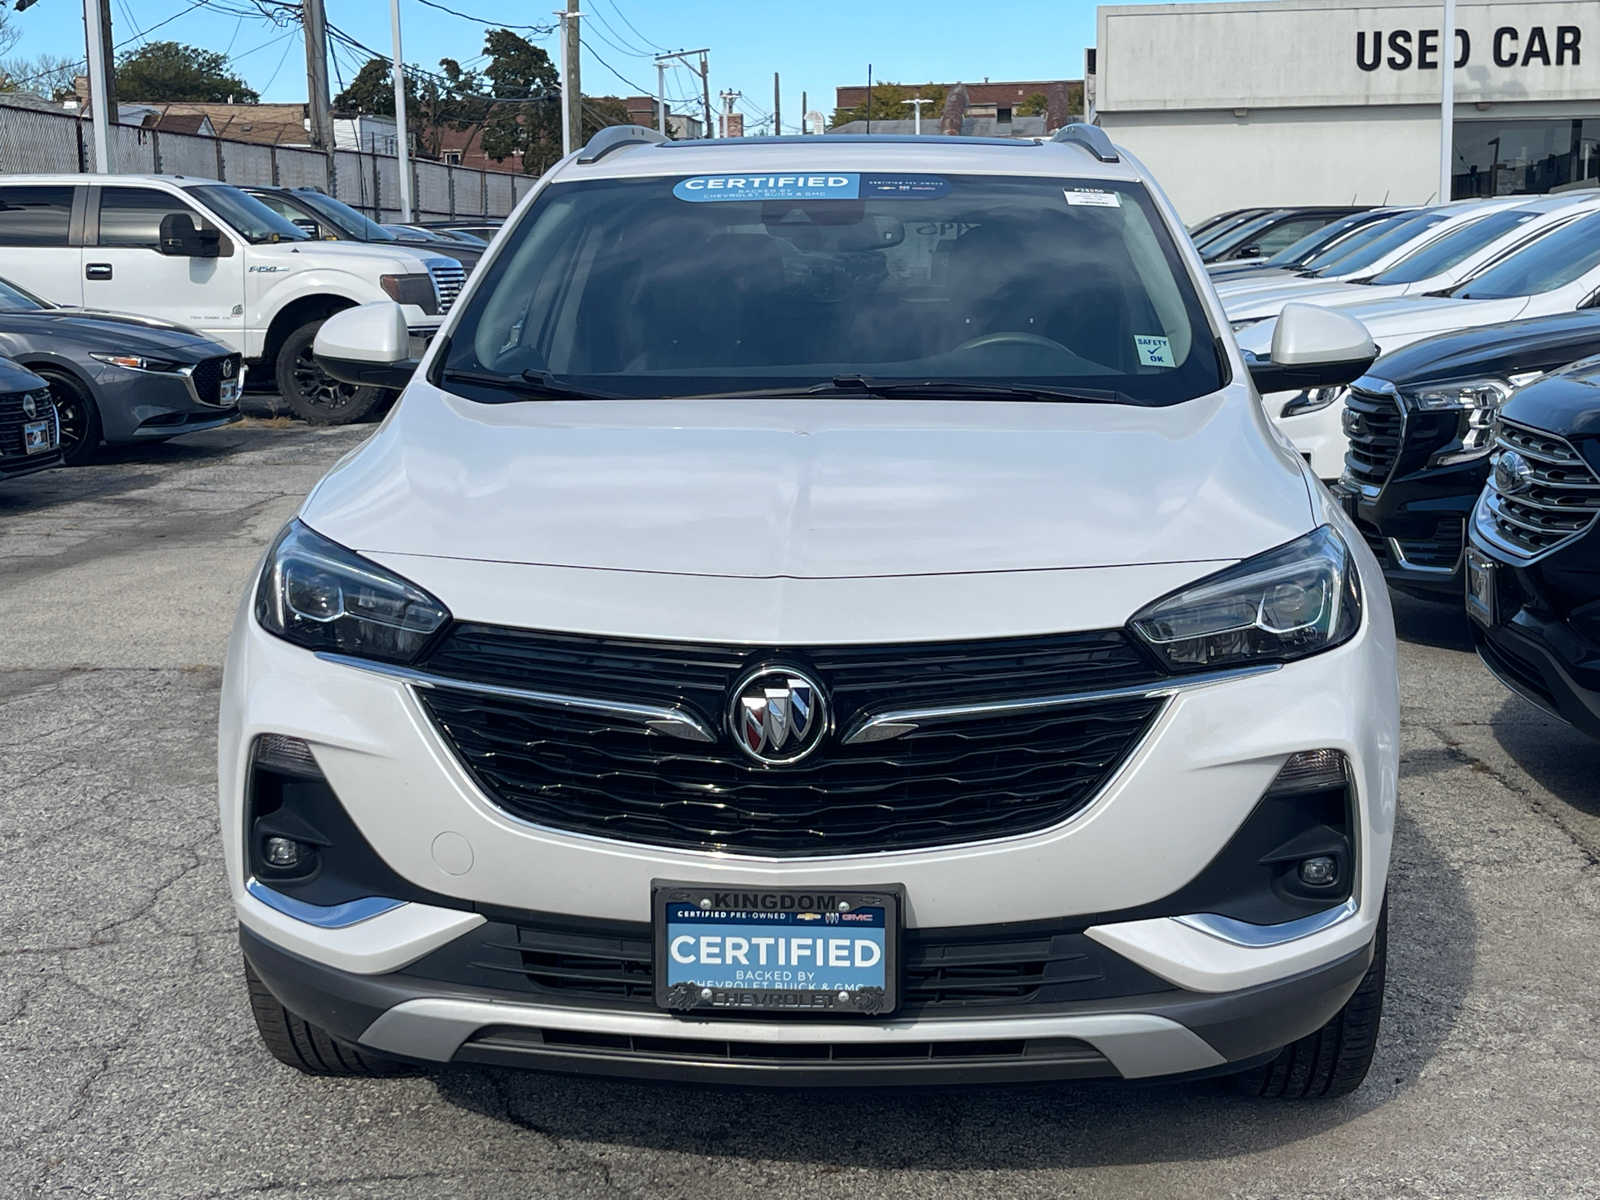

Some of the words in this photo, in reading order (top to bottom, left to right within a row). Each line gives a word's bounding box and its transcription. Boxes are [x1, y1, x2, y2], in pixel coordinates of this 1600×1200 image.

[1356, 29, 1471, 72] USED
[1492, 25, 1582, 68] CAR
[684, 176, 850, 190] CERTIFIED
[1137, 338, 1167, 347] SAFETY
[1150, 355, 1165, 363] OK
[715, 892, 836, 910] KINGDOM
[677, 910, 727, 919] CERTIFIED
[730, 911, 786, 920] PRE-OWNED
[842, 913, 873, 922] GMC
[670, 935, 881, 968] CERTIFIED
[736, 970, 792, 981] BACKED
[797, 971, 815, 981] BY
[775, 982, 816, 990] BUICK
[712, 992, 838, 1008] CHEVROLET
